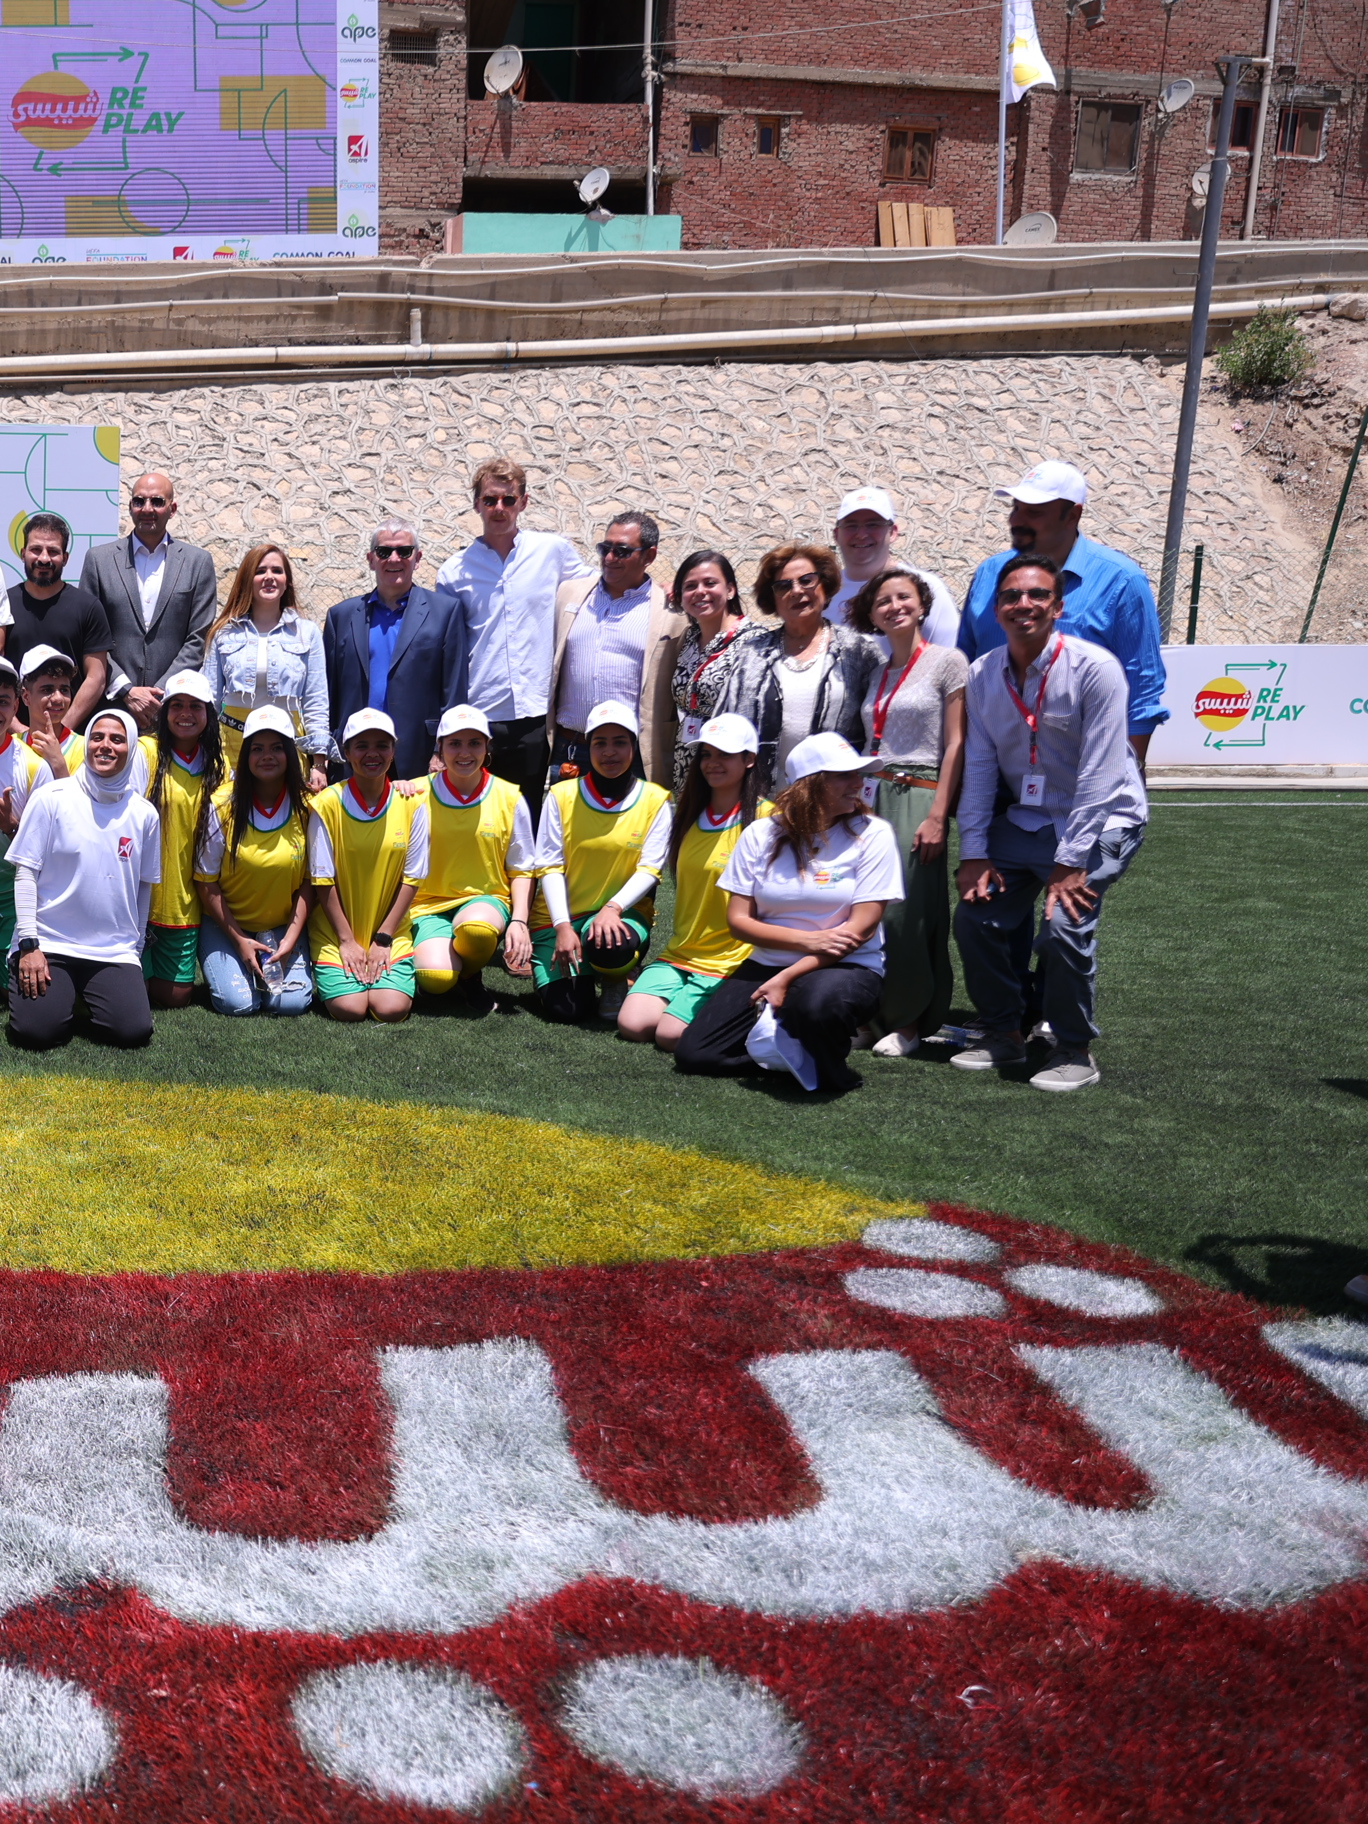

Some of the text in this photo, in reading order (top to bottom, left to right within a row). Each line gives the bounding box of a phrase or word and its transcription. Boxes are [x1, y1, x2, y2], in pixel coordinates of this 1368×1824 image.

[341, 26, 377, 43] ape
[107, 86, 148, 110] RE
[101, 111, 185, 135] PLAY
[341, 225, 377, 239] ape
[238, 249, 249, 258] RE
[1256, 687, 1283, 704] RE
[1250, 704, 1306, 721] PLAY
